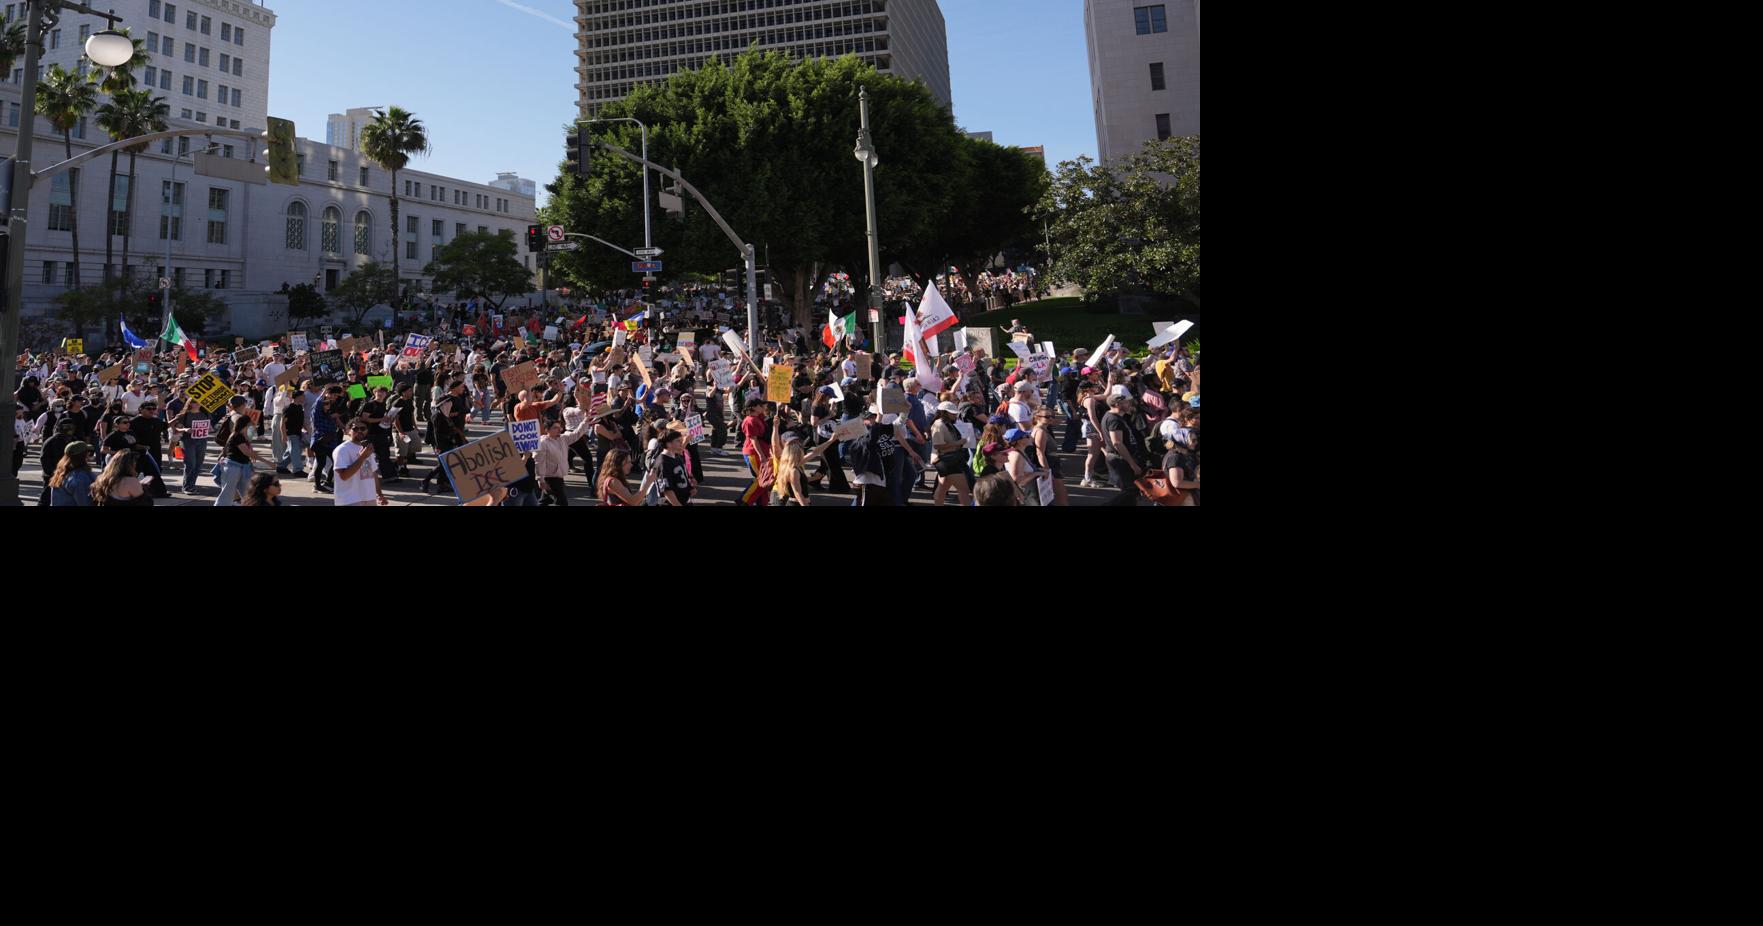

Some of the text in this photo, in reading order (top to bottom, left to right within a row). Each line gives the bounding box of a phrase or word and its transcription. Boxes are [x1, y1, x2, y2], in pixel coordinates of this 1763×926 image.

[188, 375, 216, 399] STOP
[512, 420, 536, 433] DO NOT
[686, 416, 701, 428] ICE
[192, 428, 208, 438] ICE
[513, 432, 538, 441] LOOK
[689, 425, 703, 437] OUT
[515, 440, 538, 451] AWAY
[446, 437, 514, 479] Abolish
[471, 466, 510, 493] ICE
